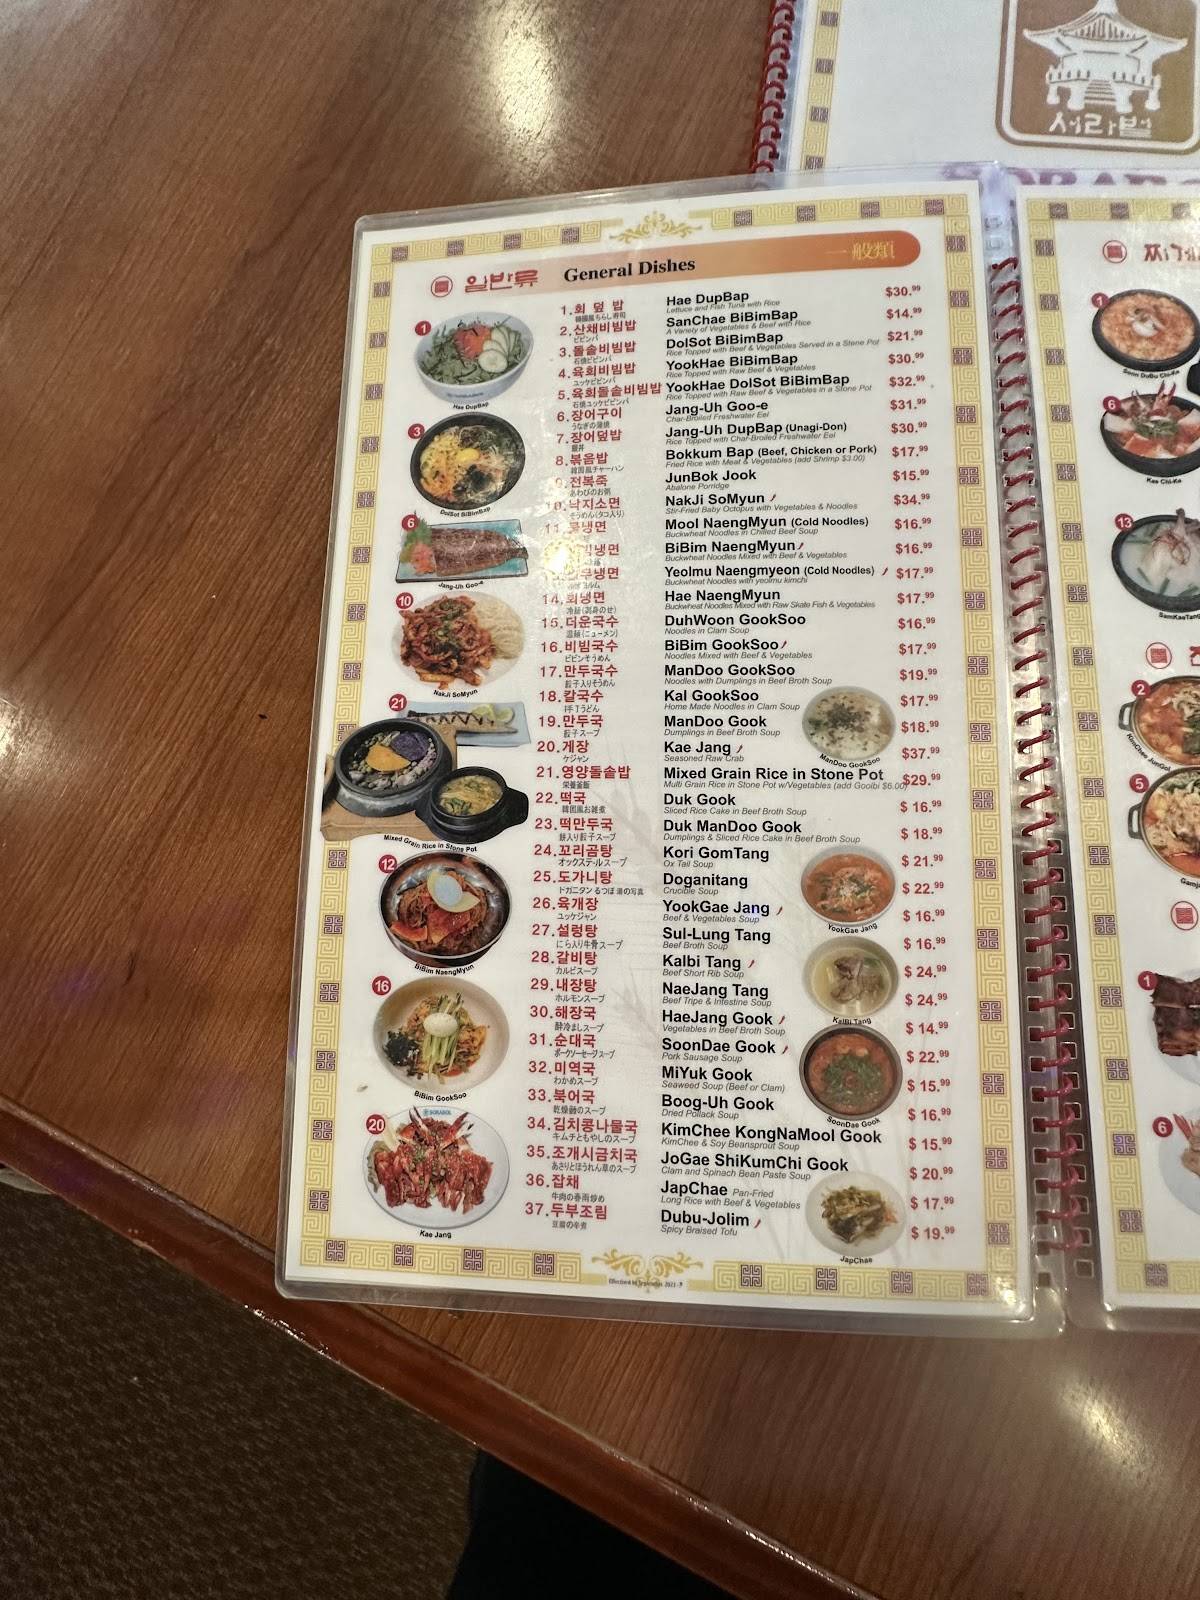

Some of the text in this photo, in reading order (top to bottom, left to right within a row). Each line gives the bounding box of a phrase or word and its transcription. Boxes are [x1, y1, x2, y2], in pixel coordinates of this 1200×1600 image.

[1048, 113, 1152, 138] 서라벌
[564, 257, 695, 283] General Dishes
[464, 269, 539, 294] 일반류
[667, 292, 749, 306] Hae DupBap
[666, 310, 798, 327] SanChae BiBimBap
[666, 333, 783, 349] DolSot BiBimBap
[666, 354, 798, 370] YookHae BiBimBap
[666, 374, 850, 392] YookHae DolSot BiBimBap
[666, 401, 768, 416] Jang-Uh Goo-e
[665, 422, 847, 439] Jang-Uh DupBap (Unagi-Don)
[666, 448, 722, 460] Bokkum
[726, 447, 754, 460] Bap
[758, 448, 787, 458] (Beef,
[790, 446, 832, 455] Chicken
[849, 445, 877, 454] Pork)
[665, 469, 756, 483] JunBok Jook
[666, 483, 729, 491] Abalone Porridge
[666, 493, 764, 506] NakJi SoMyun
[666, 516, 868, 530] Mool NaengMyun (Cold Noodles)
[666, 540, 795, 554] BiBim NaengMyun
[664, 565, 874, 579] Yeolmu Naengmyeon (Cold Noodles)
[665, 589, 780, 602] Hae NaengMyun
[665, 613, 806, 626] DuhWoon GookSoo
[730, 627, 750, 635] Soup
[665, 638, 778, 651] BiBim GookSoo
[664, 664, 795, 676] ManDoo GookSoo
[664, 689, 759, 702] Kal GookSoo
[664, 715, 767, 727] ManDoo Gook
[664, 741, 731, 756] Kae Jang
[664, 754, 744, 762] Seasoned Raw Crab
[819, 753, 881, 768] ManDoo GookSoo
[664, 767, 884, 780] Mixed Grain Rice in Stone Pot
[664, 793, 736, 806] Duk Gook
[664, 820, 802, 833] Duk ManDoo Gook
[664, 846, 769, 863] Kori GomTang
[664, 872, 748, 890] Doganitang
[662, 900, 770, 917] YookGae Jang
[662, 926, 770, 944] Sul-Lung Tang
[828, 922, 878, 934] YookGae Jang
[663, 954, 741, 972] Kalbi Tang
[663, 982, 768, 1000] NaeJang Tang
[662, 1010, 773, 1025] HaeJang Gook
[662, 1038, 776, 1054] SoonDae Gook
[662, 1053, 742, 1063] Pork Sausage Soup
[662, 1066, 752, 1081] MiYuk Gook
[414, 1091, 466, 1101] BiBim GookSoo
[662, 1094, 774, 1112] Boog-Uh Gook
[827, 1116, 880, 1128] SoonDae Gook
[662, 1122, 882, 1143] KimChee KongNaMool Gook
[661, 1151, 848, 1172] JoGae ShiKumChi Gook
[660, 1180, 728, 1197] JapChae
[661, 1209, 749, 1226] Dubu-Jolim
[420, 1230, 432, 1238] Kae
[661, 1225, 738, 1236] Spicy Braised Tofu
[840, 1256, 872, 1264] JapChae
